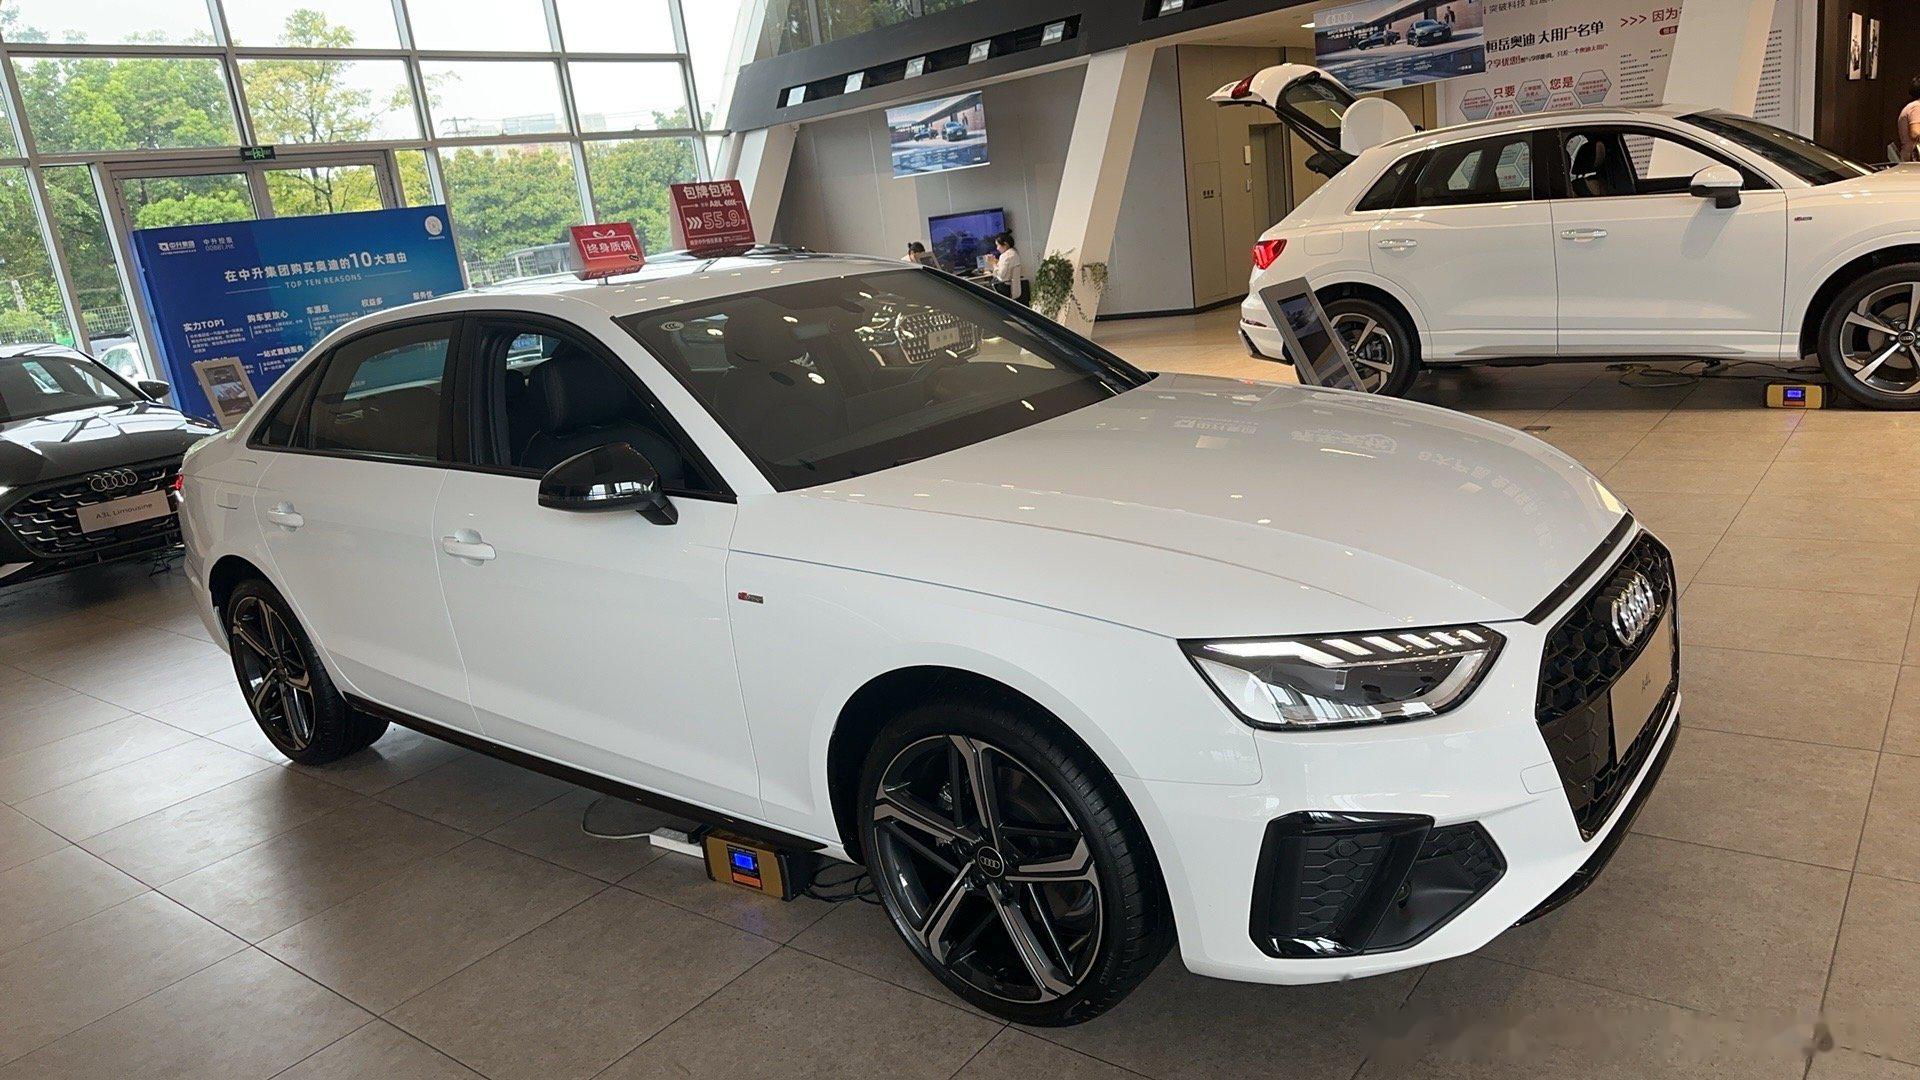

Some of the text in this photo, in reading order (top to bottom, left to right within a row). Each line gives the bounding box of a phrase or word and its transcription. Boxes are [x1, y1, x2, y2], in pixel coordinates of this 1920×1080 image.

[1653, 7, 1682, 22] 因为
[1539, 20, 1604, 44] 大用户名单
[1549, 76, 1574, 90] 您是
[1493, 85, 1516, 99] 只要
[683, 183, 734, 200] 包牌包税
[586, 241, 632, 254] 终身质保
[284, 273, 362, 290] TOP TEN REASONS
[246, 310, 289, 323] 购车更放心
[183, 318, 225, 332] 实力TOP1
[113, 503, 153, 516] Limousine
